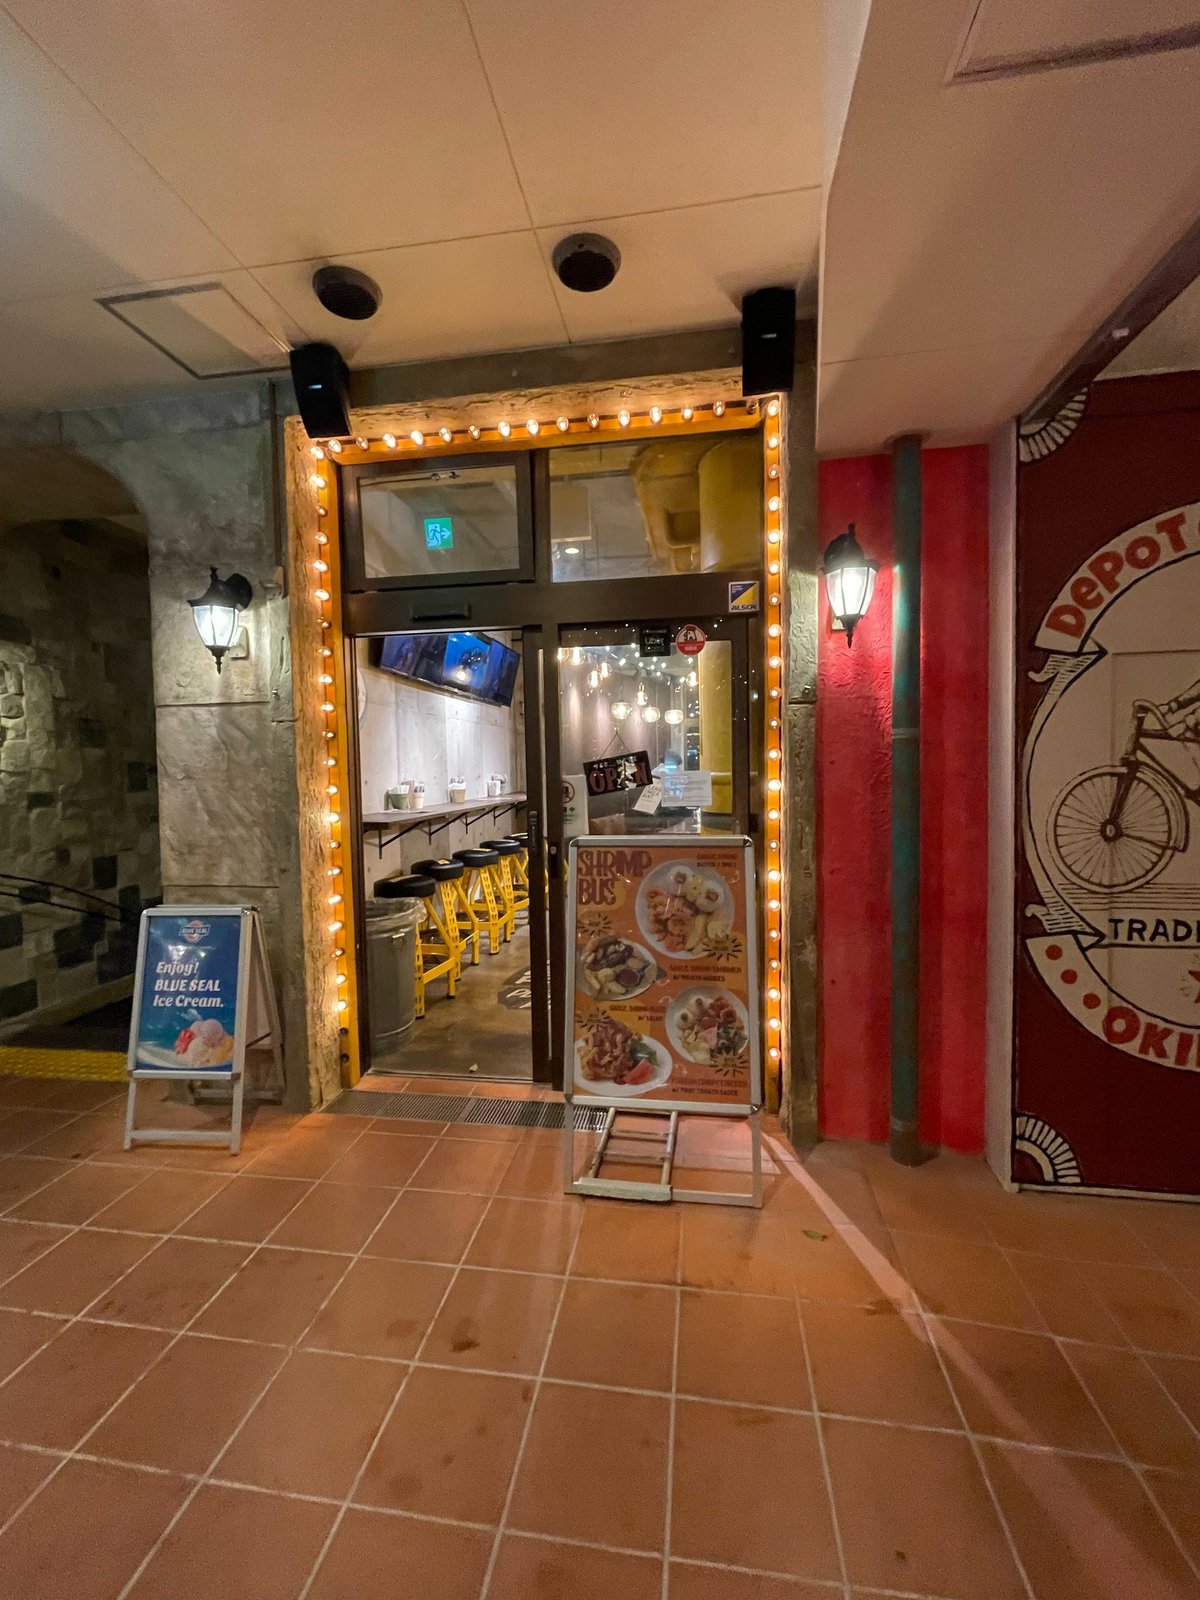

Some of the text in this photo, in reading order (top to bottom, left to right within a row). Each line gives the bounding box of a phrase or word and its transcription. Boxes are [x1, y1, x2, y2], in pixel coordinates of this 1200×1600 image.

[589, 761, 650, 792] OPN
[578, 850, 652, 879] SHRIMP
[579, 878, 616, 905] BUS
[1108, 918, 1200, 943] TRAD
[156, 961, 199, 976] Enjoy!
[154, 979, 221, 991] BLUE SEAL
[153, 994, 224, 1007] Ice Cream.
